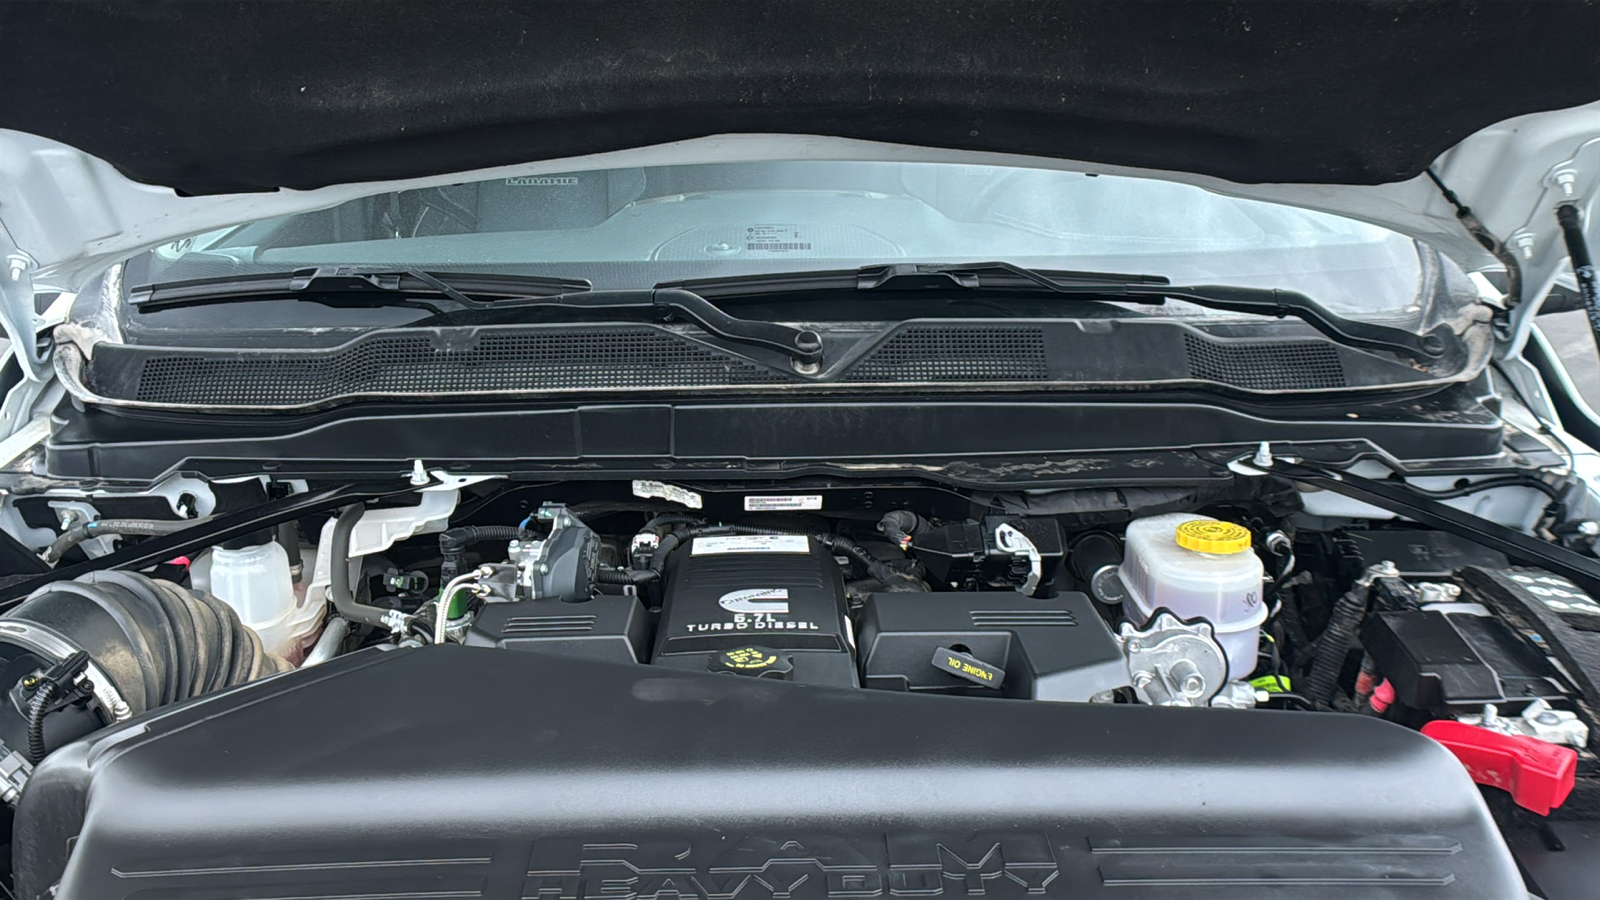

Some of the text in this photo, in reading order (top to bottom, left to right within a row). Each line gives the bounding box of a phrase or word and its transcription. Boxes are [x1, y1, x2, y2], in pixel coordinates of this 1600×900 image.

[734, 613, 777, 623] 6.7L
[687, 621, 819, 632] TURBO DIESEL
[947, 656, 993, 681] ENGINE OIL
